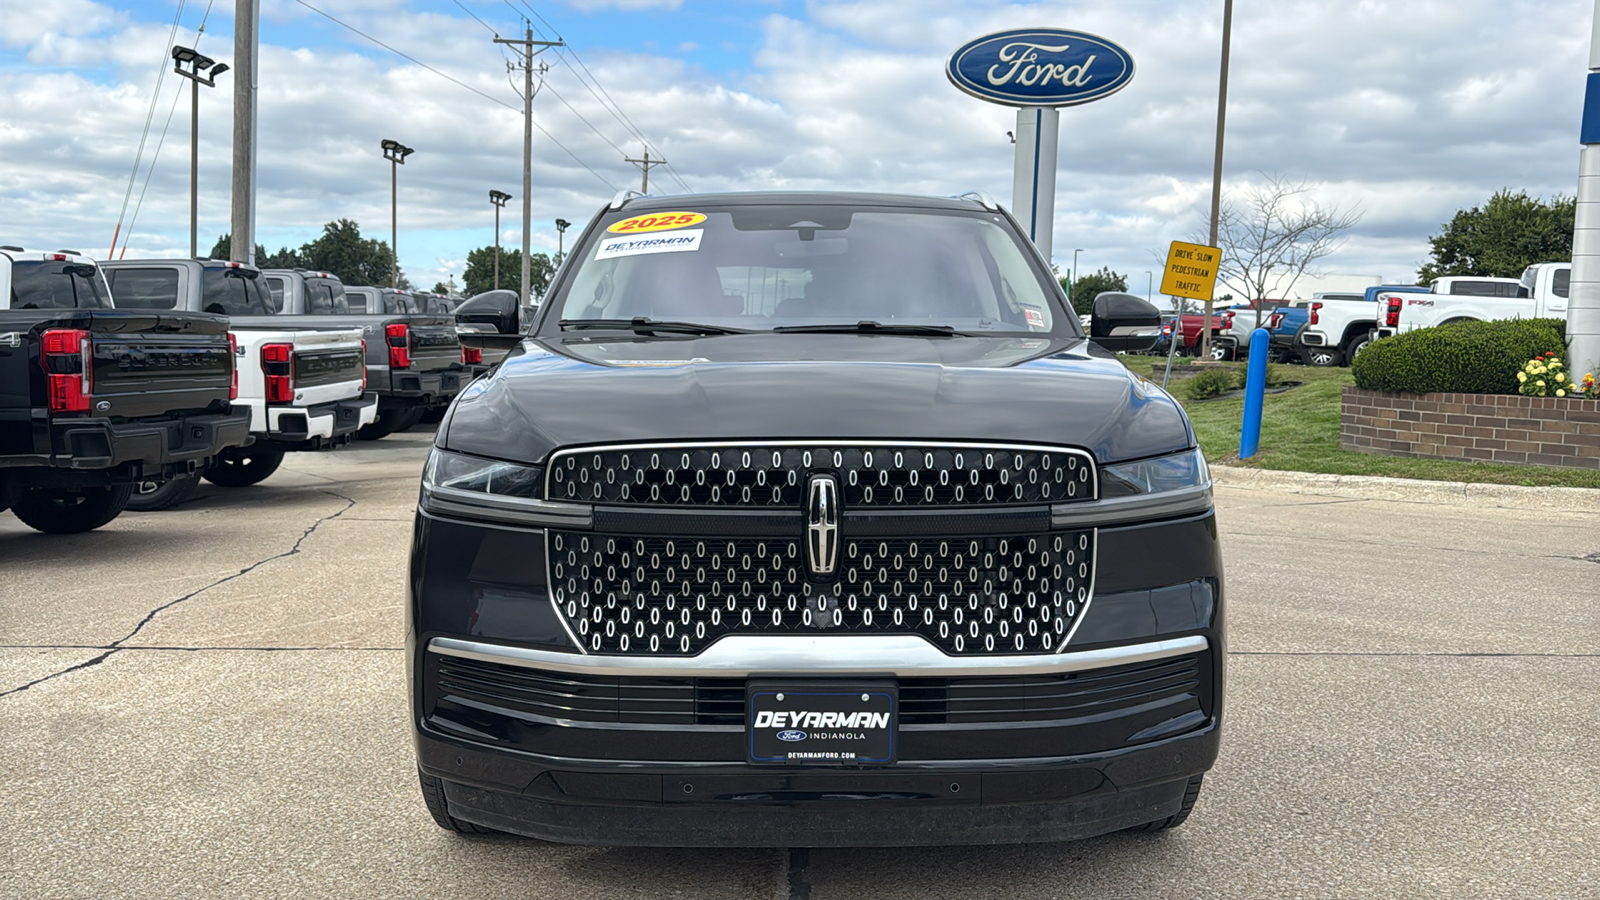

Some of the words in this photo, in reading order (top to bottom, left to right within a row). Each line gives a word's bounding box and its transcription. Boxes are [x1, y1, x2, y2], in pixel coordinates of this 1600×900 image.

[987, 42, 1097, 87] Ford
[617, 215, 695, 230] 2025
[605, 237, 695, 251] DEYARMAN
[1175, 249, 1194, 260] DRIVE
[1196, 252, 1213, 263] SLOW
[1171, 264, 1209, 277] PEDESTRIAN
[1175, 280, 1201, 292] TRAFFIC
[754, 711, 890, 729] DEYARMAN
[782, 731, 801, 740] Ford
[809, 732, 866, 740] INDIANOLA
